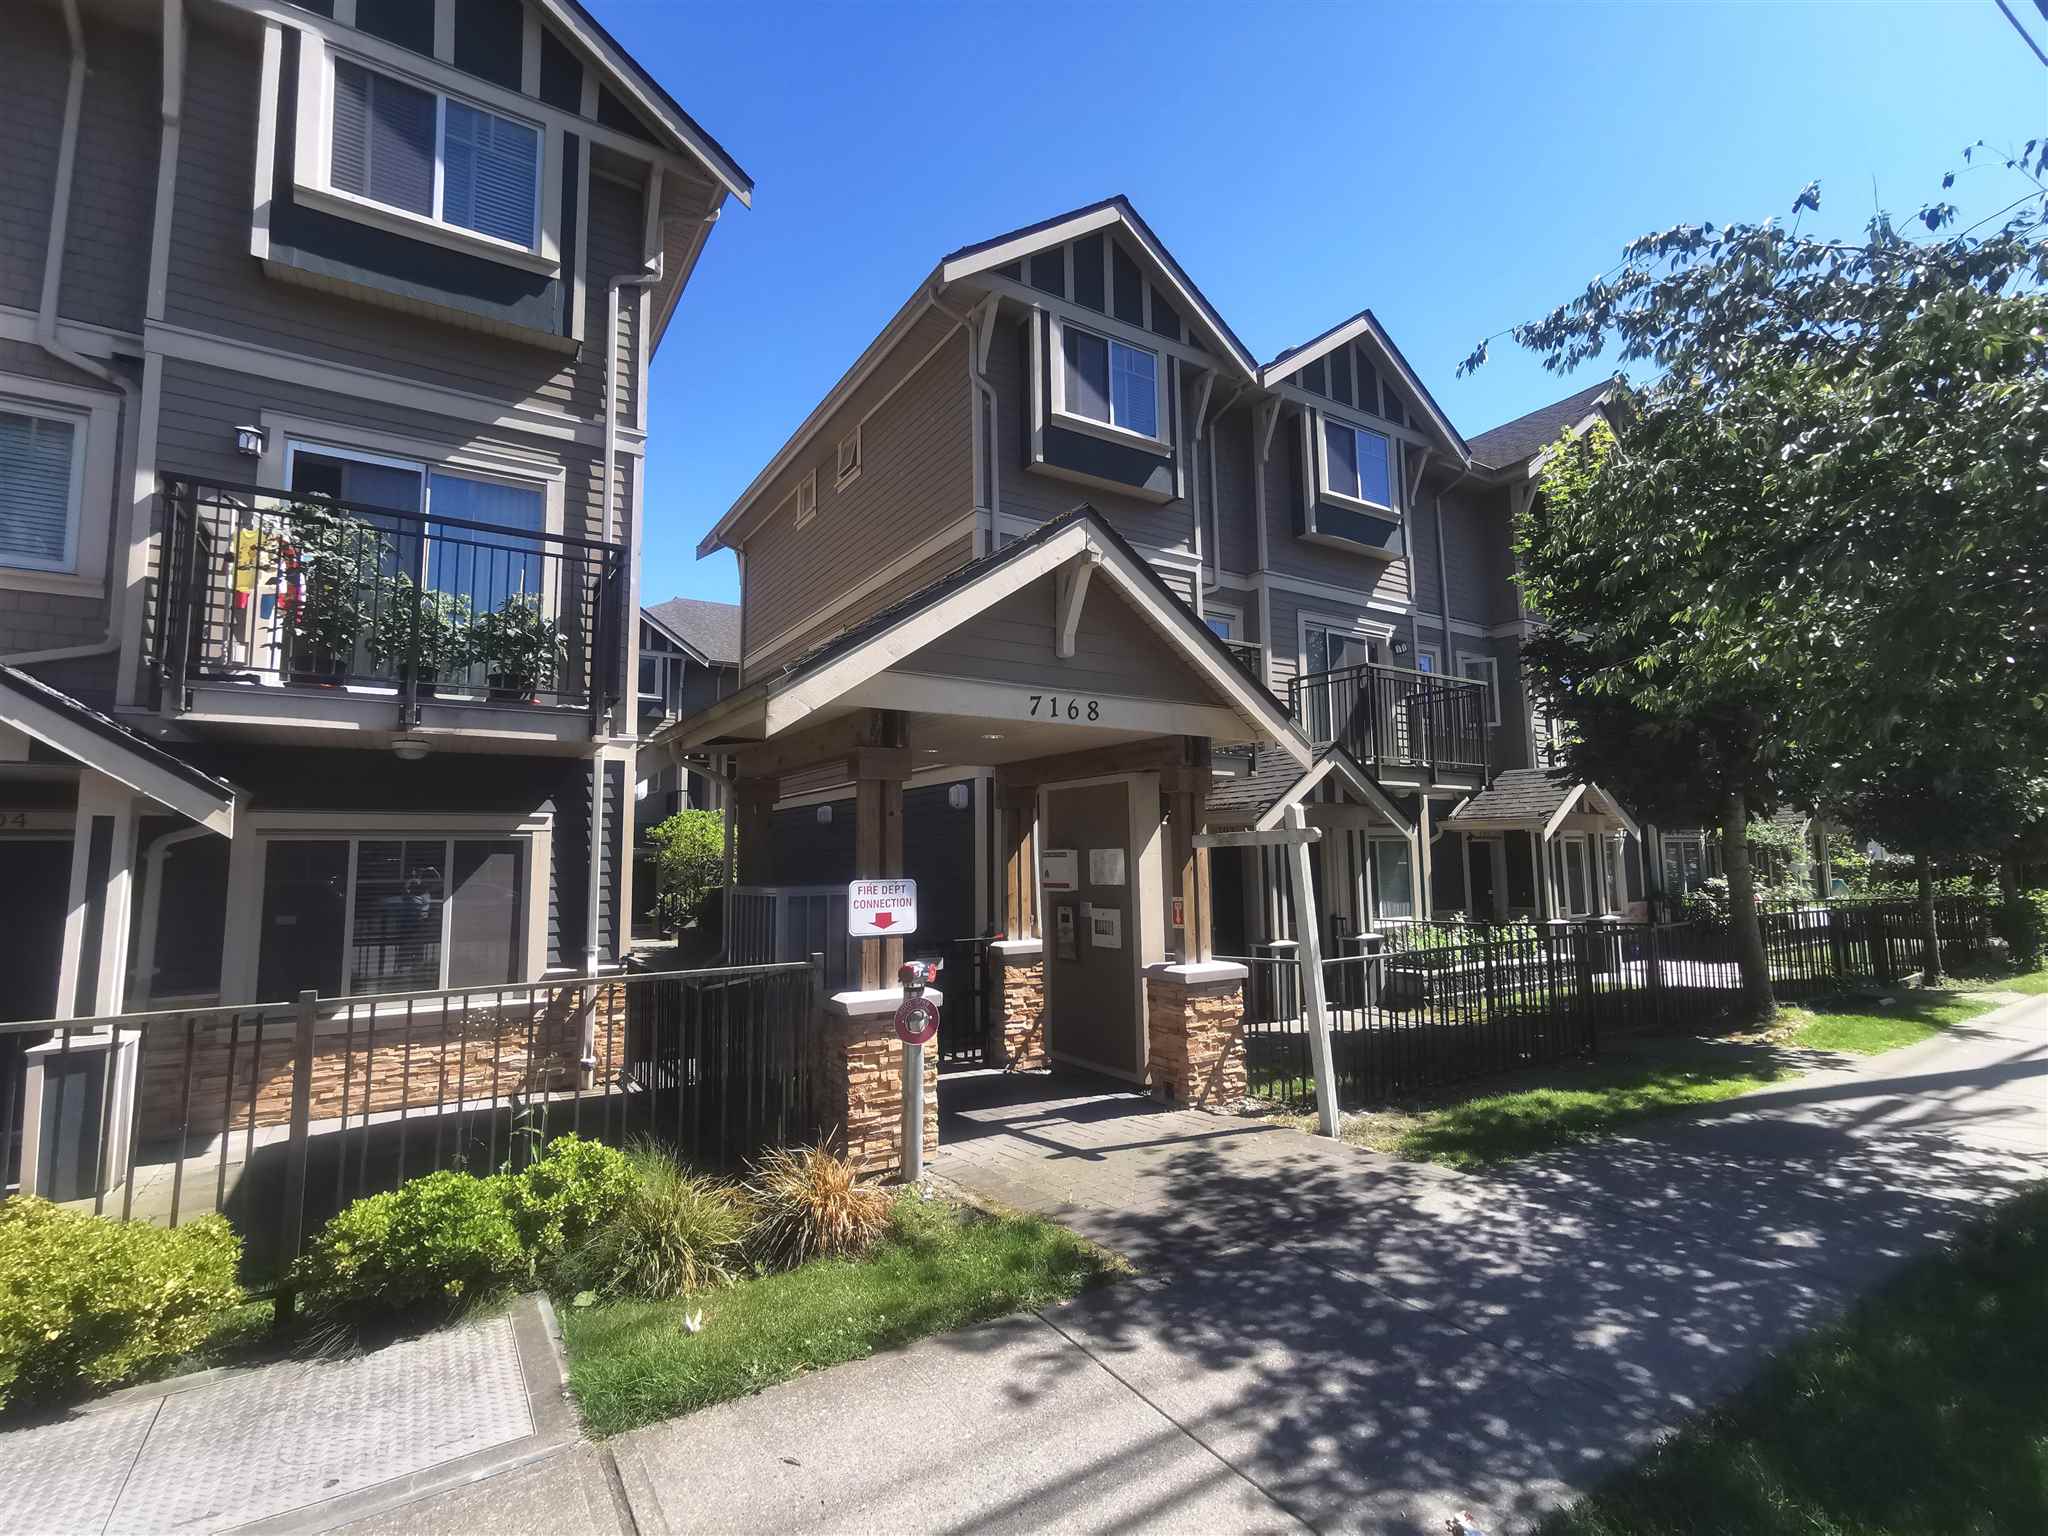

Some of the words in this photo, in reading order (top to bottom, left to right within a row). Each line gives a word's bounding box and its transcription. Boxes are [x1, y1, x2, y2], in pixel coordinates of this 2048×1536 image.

[1030, 695, 1099, 721] 7168
[857, 885, 879, 895] FIRE
[881, 884, 906, 895] DEPT
[853, 897, 912, 910] CONNECTION
